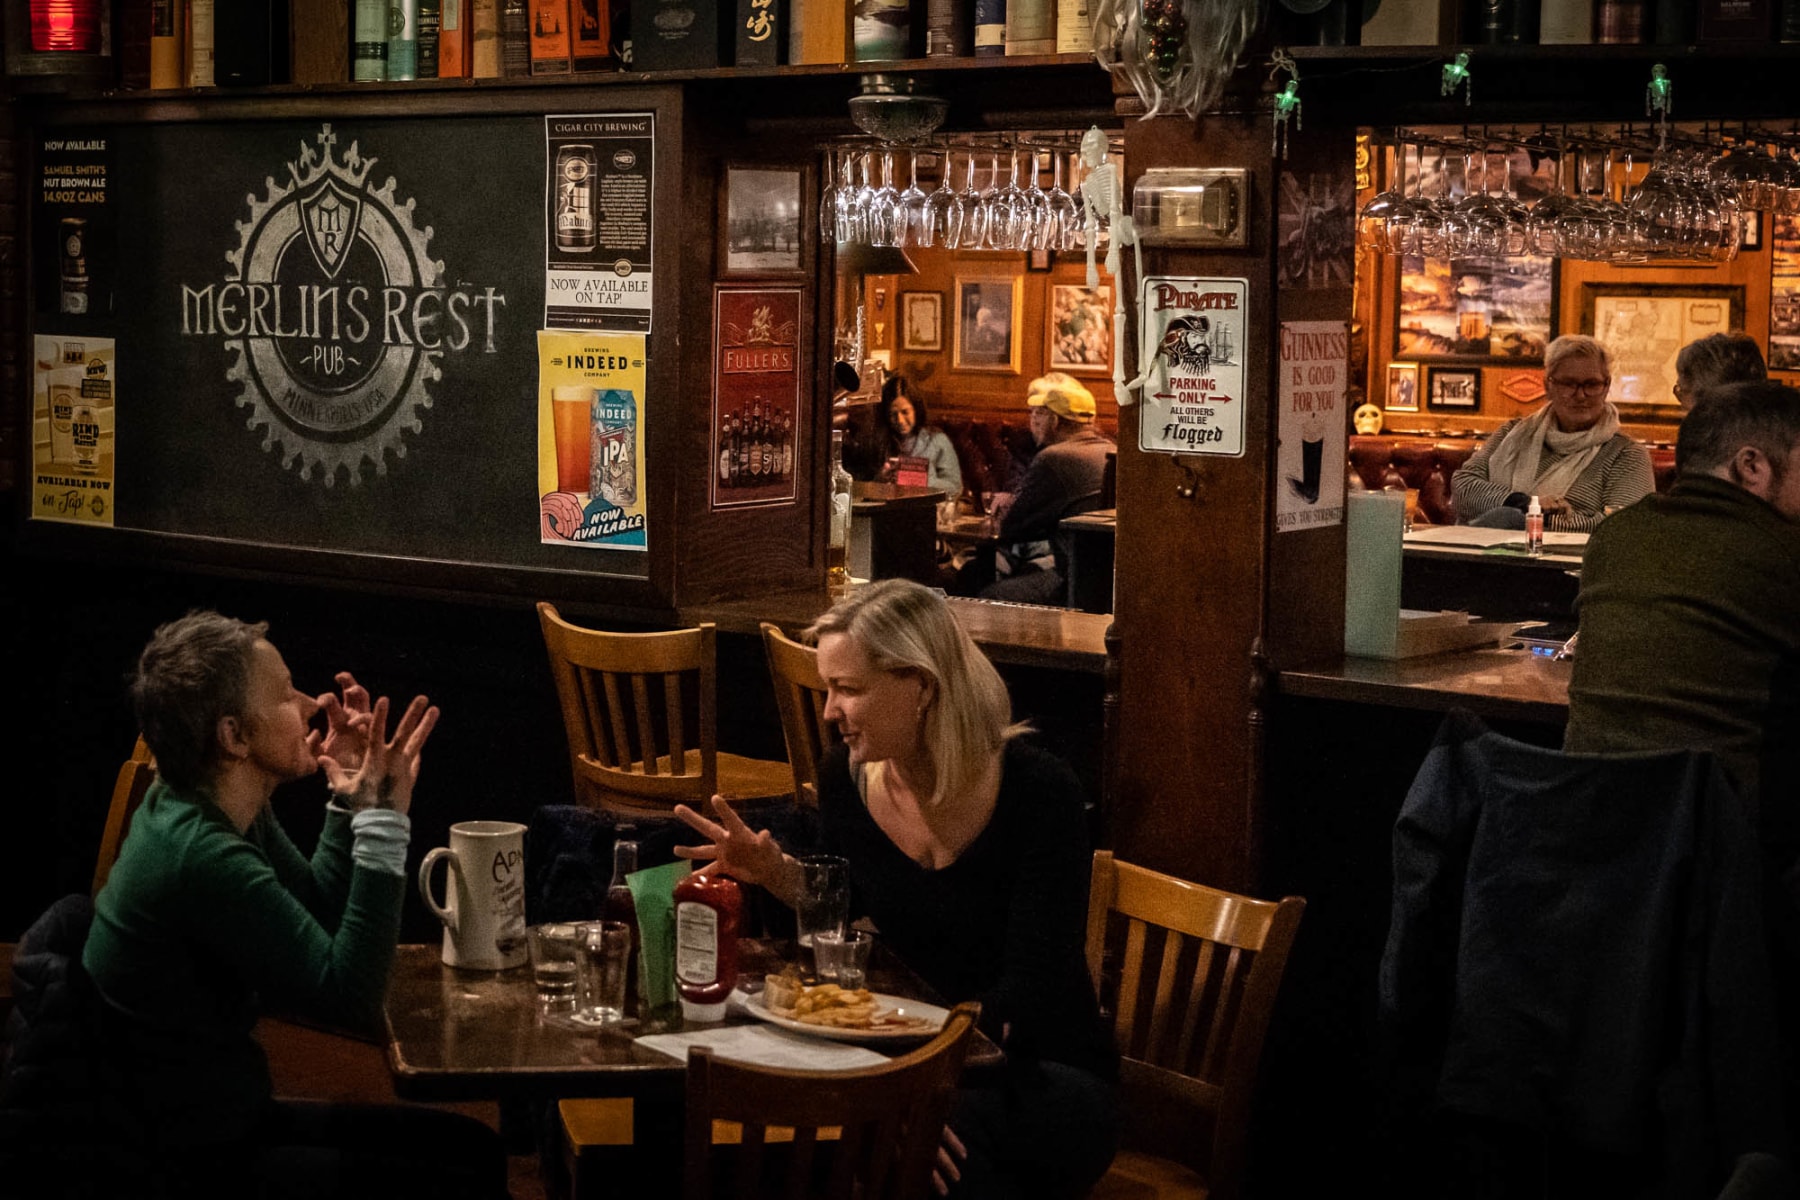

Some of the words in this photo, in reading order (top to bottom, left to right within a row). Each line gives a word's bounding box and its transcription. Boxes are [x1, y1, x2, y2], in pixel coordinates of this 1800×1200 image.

[555, 123, 581, 132] CIGAR
[584, 123, 603, 131] CITY
[605, 122, 645, 131] BREWING
[45, 141, 64, 151] NOW
[65, 140, 106, 150] AVAILABLE
[44, 165, 74, 175] SAMUEL
[75, 165, 106, 174] SMITH'S
[43, 178, 60, 188] NUT
[61, 178, 90, 188] BROWN
[91, 178, 106, 187] ALE
[77, 191, 105, 203] CANS
[551, 279, 581, 290] NOW
[584, 280, 649, 292] AVAILABLE
[575, 291, 593, 303] ON
[597, 292, 622, 304] TAP!
[1152, 283, 1239, 312] PIRATE
[382, 286, 506, 353] REST
[1280, 327, 1346, 361] GUINNESS
[313, 345, 346, 375] PUB
[567, 355, 628, 370] INDEED
[1292, 366, 1302, 386] IS
[1308, 365, 1335, 385] GOOD
[1169, 377, 1216, 391] PARKING
[1178, 391, 1207, 405] ONLY
[1292, 391, 1312, 412] FOR
[1316, 390, 1335, 411] YOU
[595, 408, 632, 420] INDEED
[1170, 406, 1184, 415] ALL
[1185, 407, 1214, 416] OTHERS
[1177, 415, 1196, 424] WILL
[1197, 416, 1207, 425] BE
[72, 423, 99, 438] RIND
[1161, 423, 1223, 444] flogged
[603, 438, 629, 466] IPA
[37, 475, 87, 488] AVAILABLE
[90, 481, 111, 490] NOW
[590, 508, 621, 525] NOW
[573, 515, 642, 541] AVAILABLE
